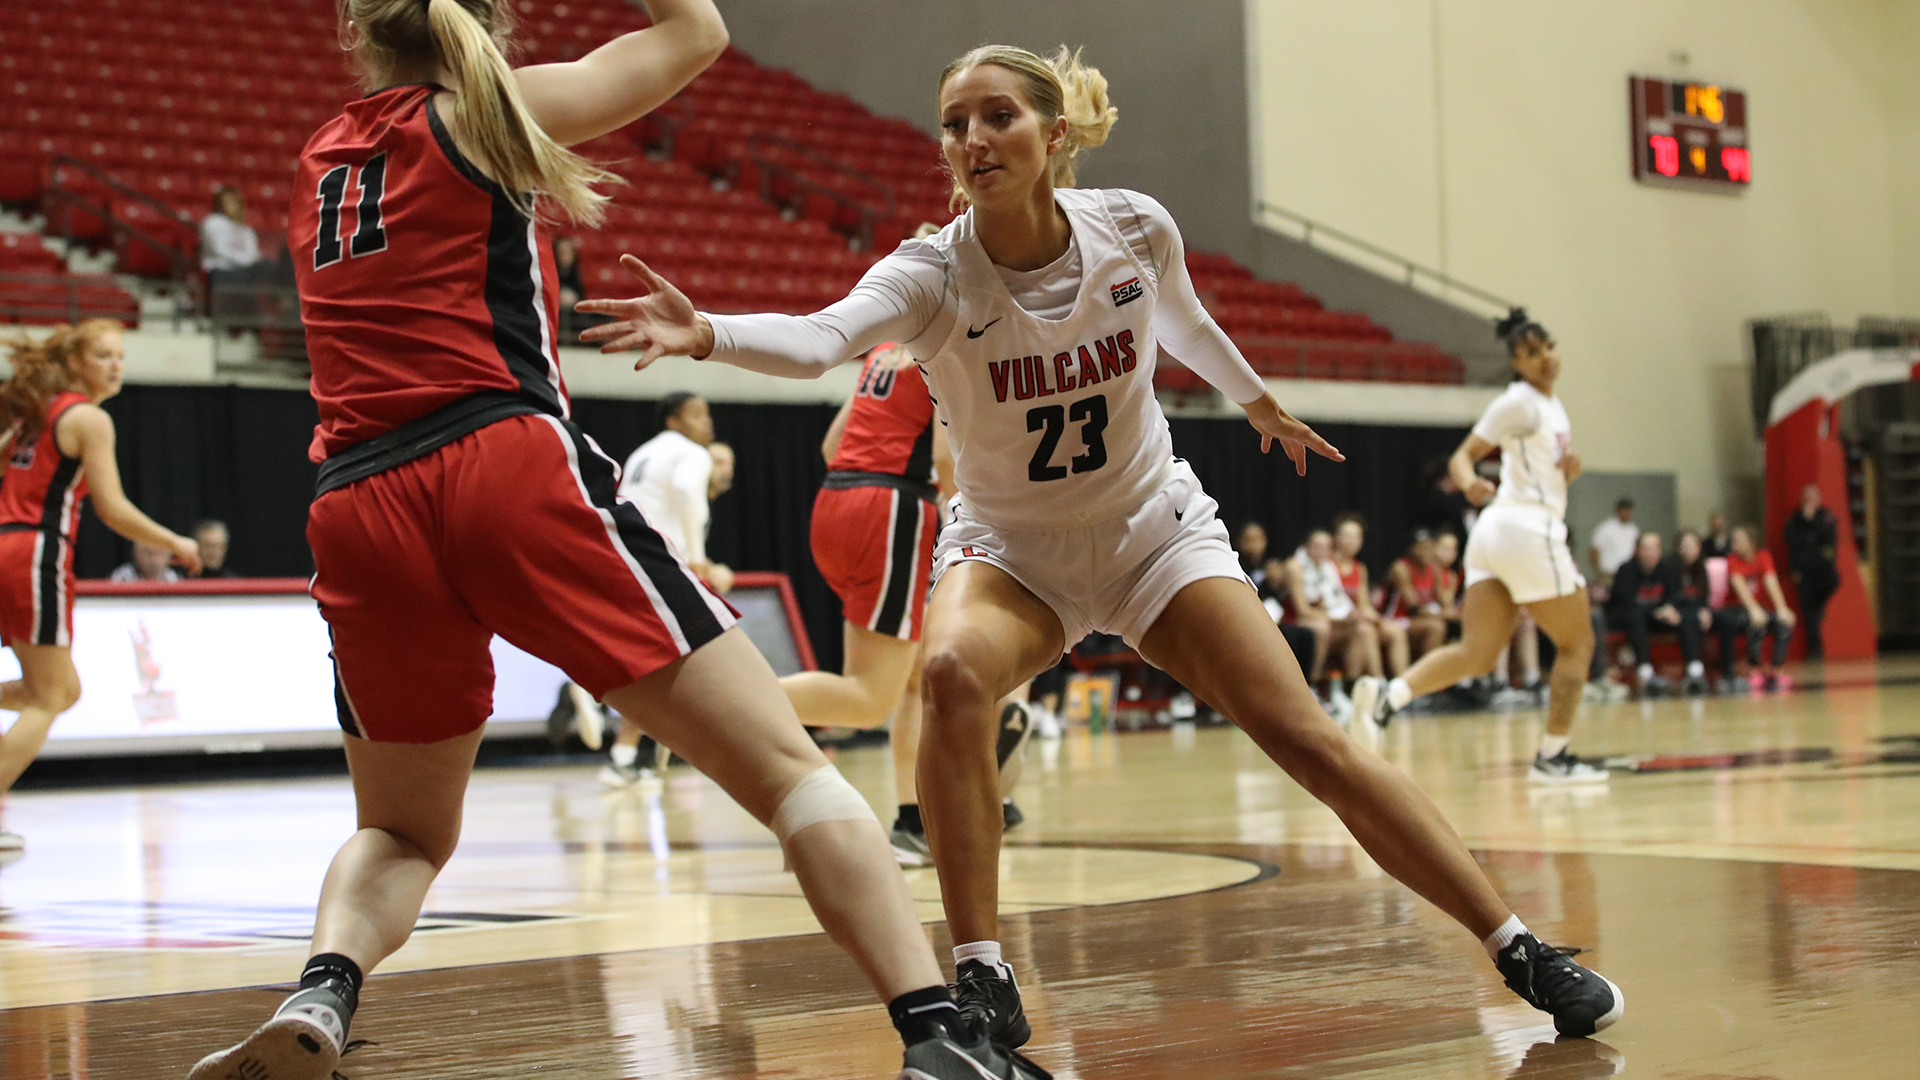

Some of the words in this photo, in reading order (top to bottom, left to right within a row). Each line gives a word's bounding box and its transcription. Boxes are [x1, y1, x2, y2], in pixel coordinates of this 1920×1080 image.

[313, 150, 389, 272] 11
[1111, 280, 1142, 302] PSAC
[988, 328, 1138, 403] VULCANS
[1026, 394, 1109, 482] 23
